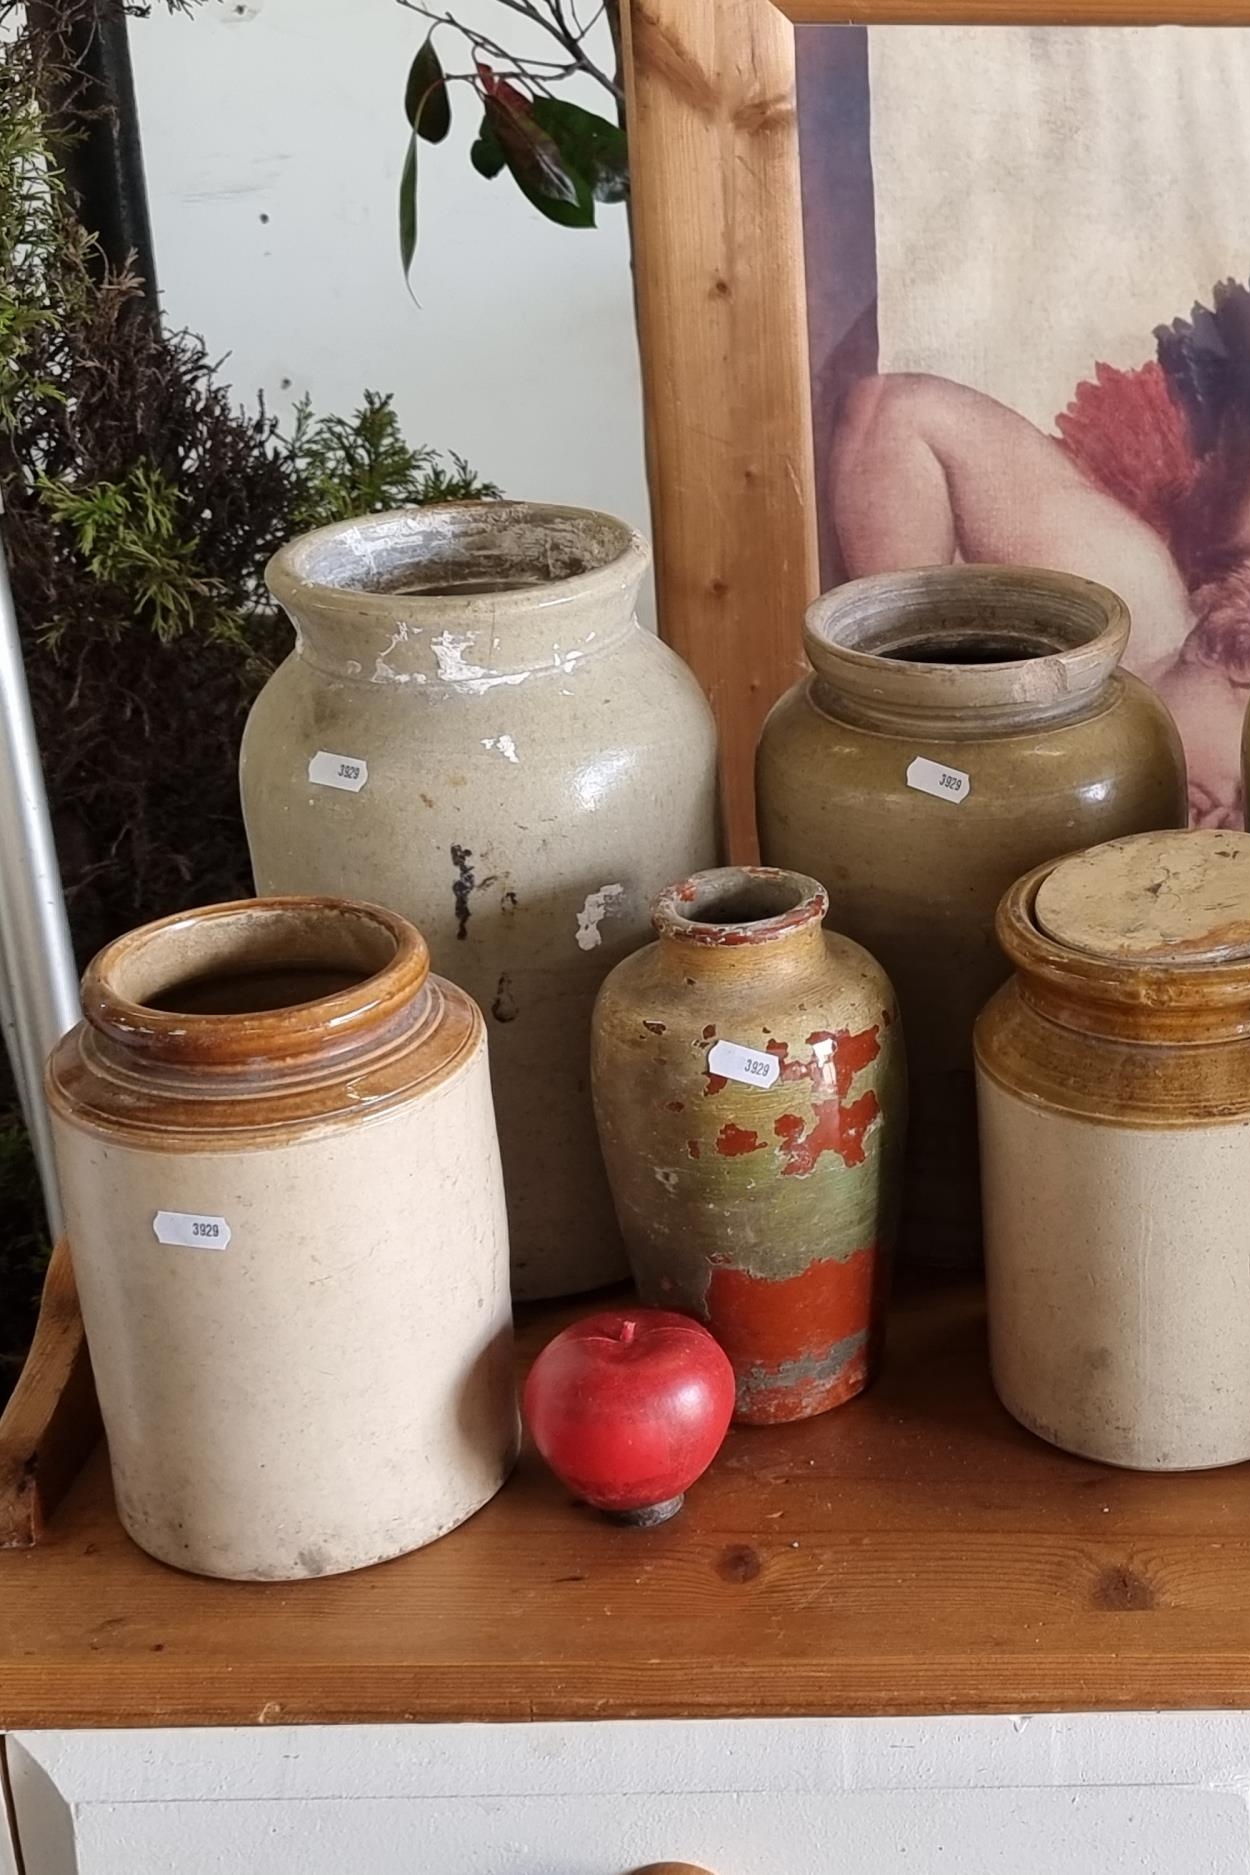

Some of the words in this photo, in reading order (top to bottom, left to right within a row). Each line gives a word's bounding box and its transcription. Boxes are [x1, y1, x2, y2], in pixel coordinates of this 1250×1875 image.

[337, 764, 360, 780] 3929
[938, 773, 962, 791] 3929
[744, 1059, 770, 1077] 3929
[192, 1222, 219, 1237] 3929
